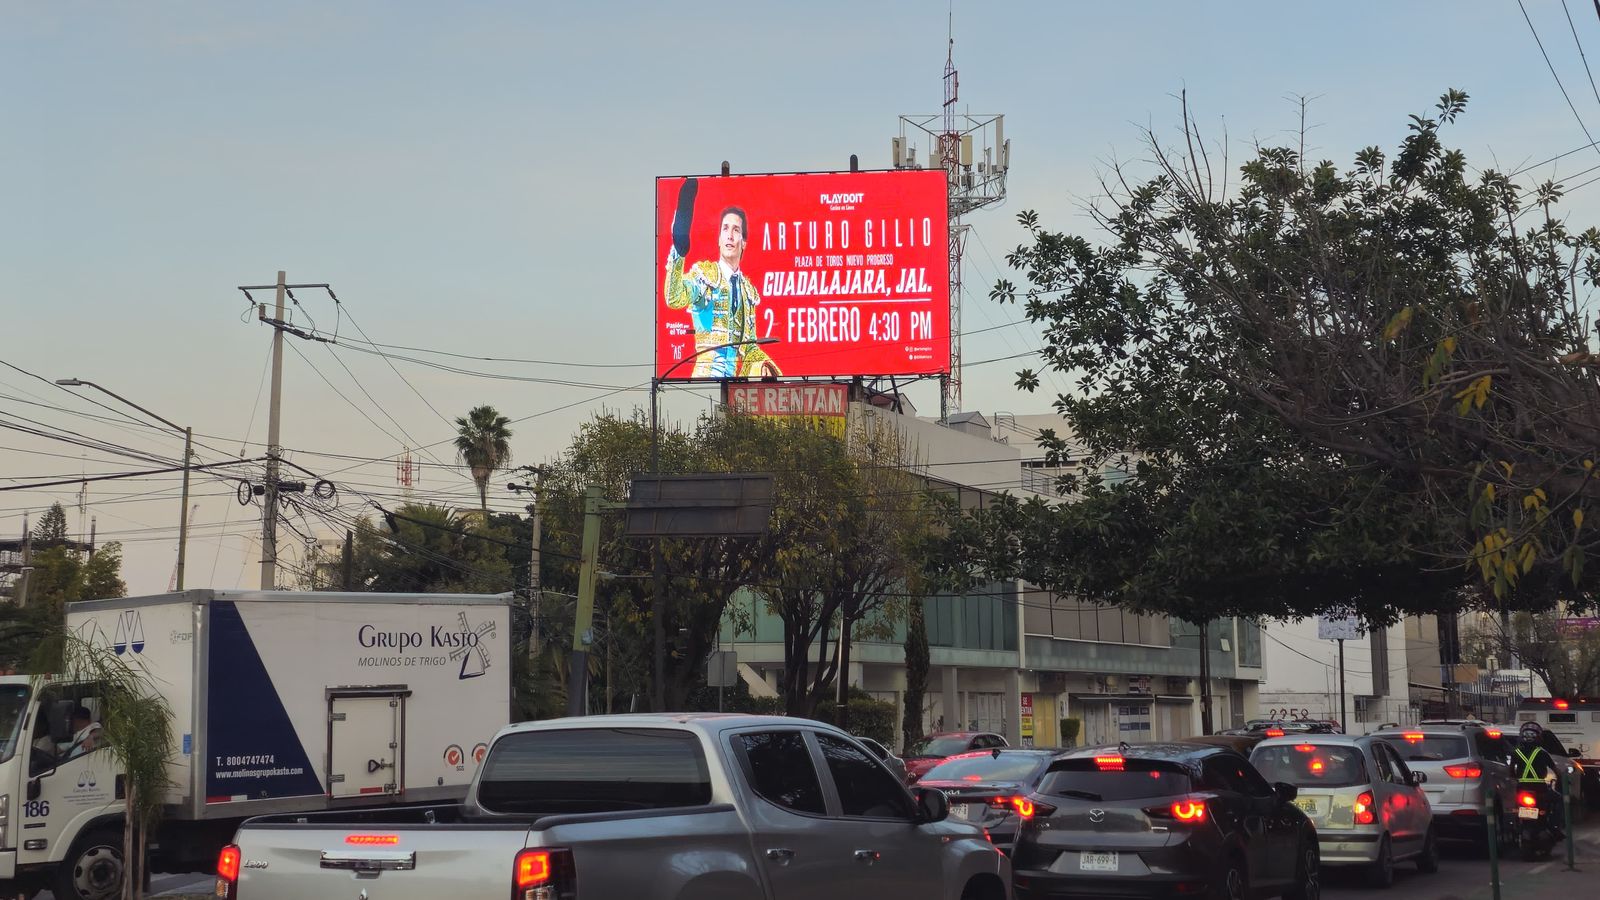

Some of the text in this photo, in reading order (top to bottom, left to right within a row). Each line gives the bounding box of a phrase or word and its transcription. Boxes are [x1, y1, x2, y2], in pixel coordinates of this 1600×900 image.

[820, 193, 864, 204] PLAYDOIT
[762, 217, 931, 251] ARTURO GILIO
[795, 253, 893, 267] PLAZA DE TOROS NUEVO PROGRESO
[762, 267, 932, 297] GUADALAJARA, JAL.
[764, 307, 932, 342] 2 FEBRERO 4:30 PM
[734, 387, 842, 413] SE RENTAN
[358, 656, 446, 667] MOLINOS DE TRIGO
[216, 754, 275, 766] T. 8004747474
[215, 767, 304, 779] www.molinosgrupokasto.com
[22, 800, 50, 818] 186
